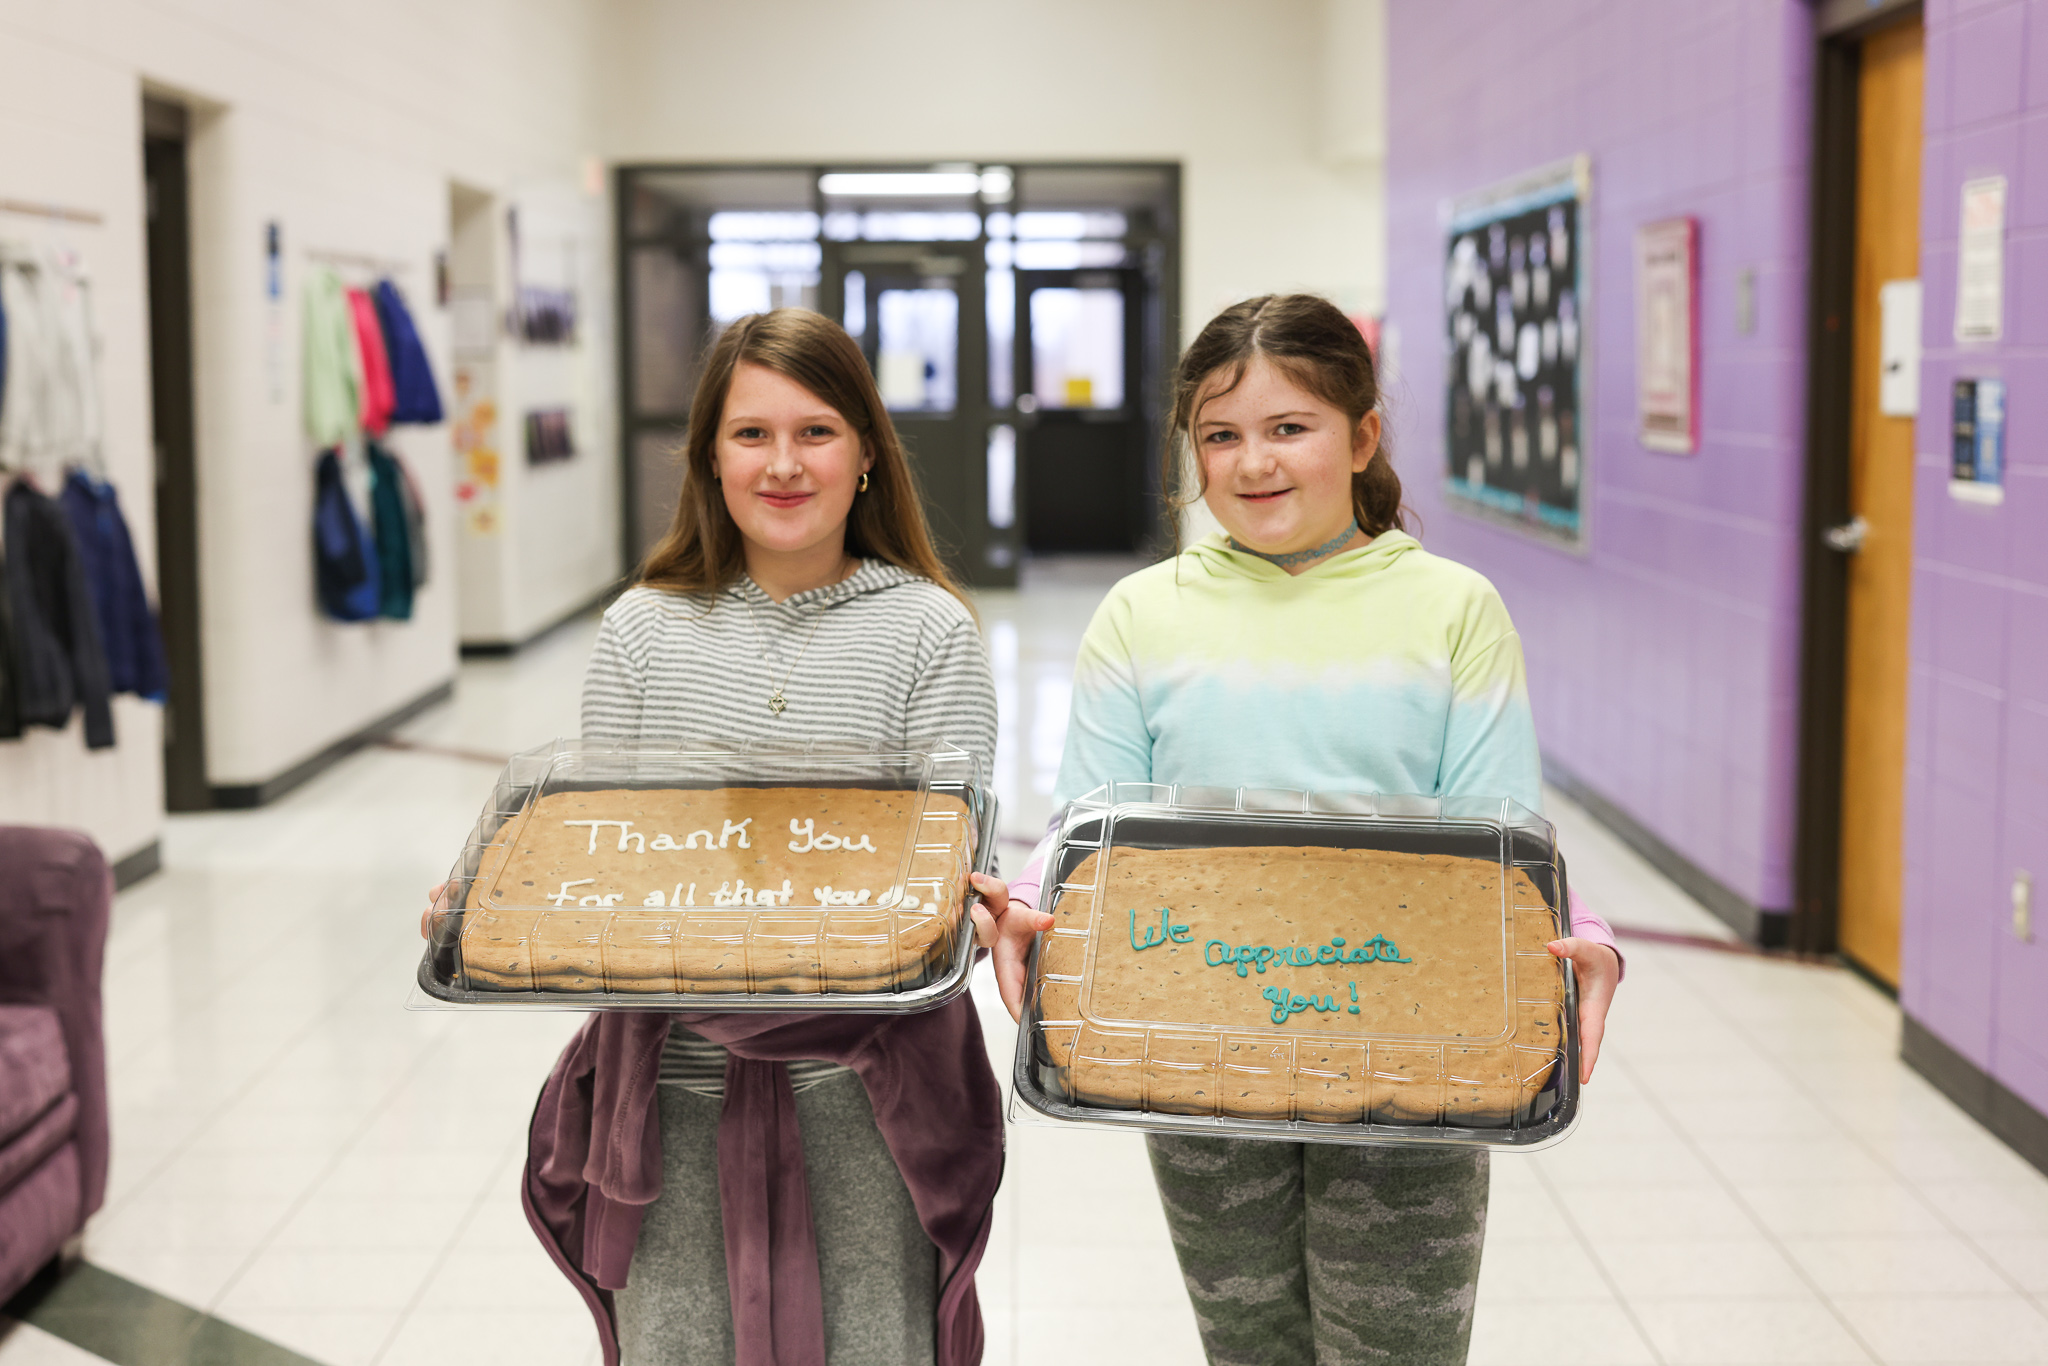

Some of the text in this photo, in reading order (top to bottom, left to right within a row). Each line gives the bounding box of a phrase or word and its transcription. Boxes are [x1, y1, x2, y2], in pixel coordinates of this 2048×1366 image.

[563, 817, 754, 855] Thank
[546, 878, 942, 914] For all that you do!
[1129, 908, 1413, 977] We appreciate
[1262, 981, 1361, 1024] you!
